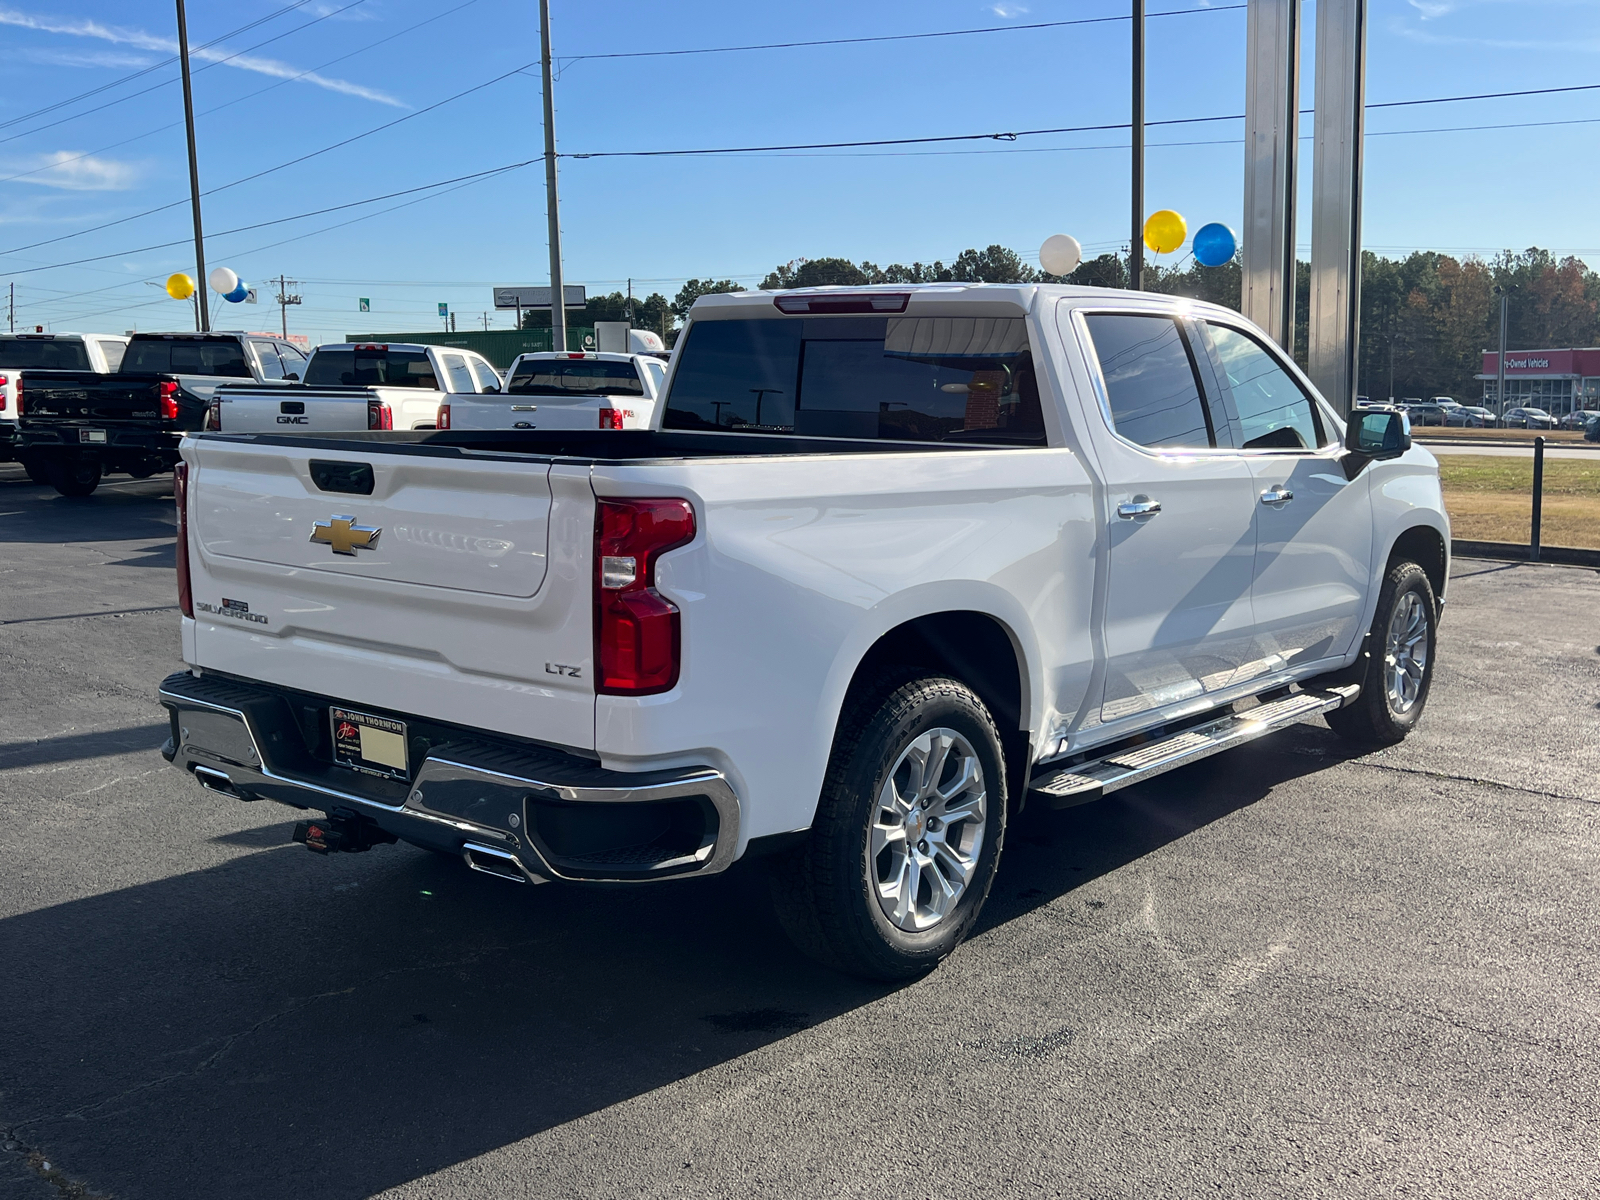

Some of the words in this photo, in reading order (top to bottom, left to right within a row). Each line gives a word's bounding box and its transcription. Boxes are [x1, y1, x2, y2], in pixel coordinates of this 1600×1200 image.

[1504, 358, 1527, 369] re-Owned
[1527, 357, 1549, 368] Vehicles
[276, 416, 309, 425] GMC
[196, 602, 269, 624] SILVERADO
[545, 662, 582, 678] LTZ
[347, 713, 364, 723] JOHN
[365, 717, 402, 731] THORNTON
